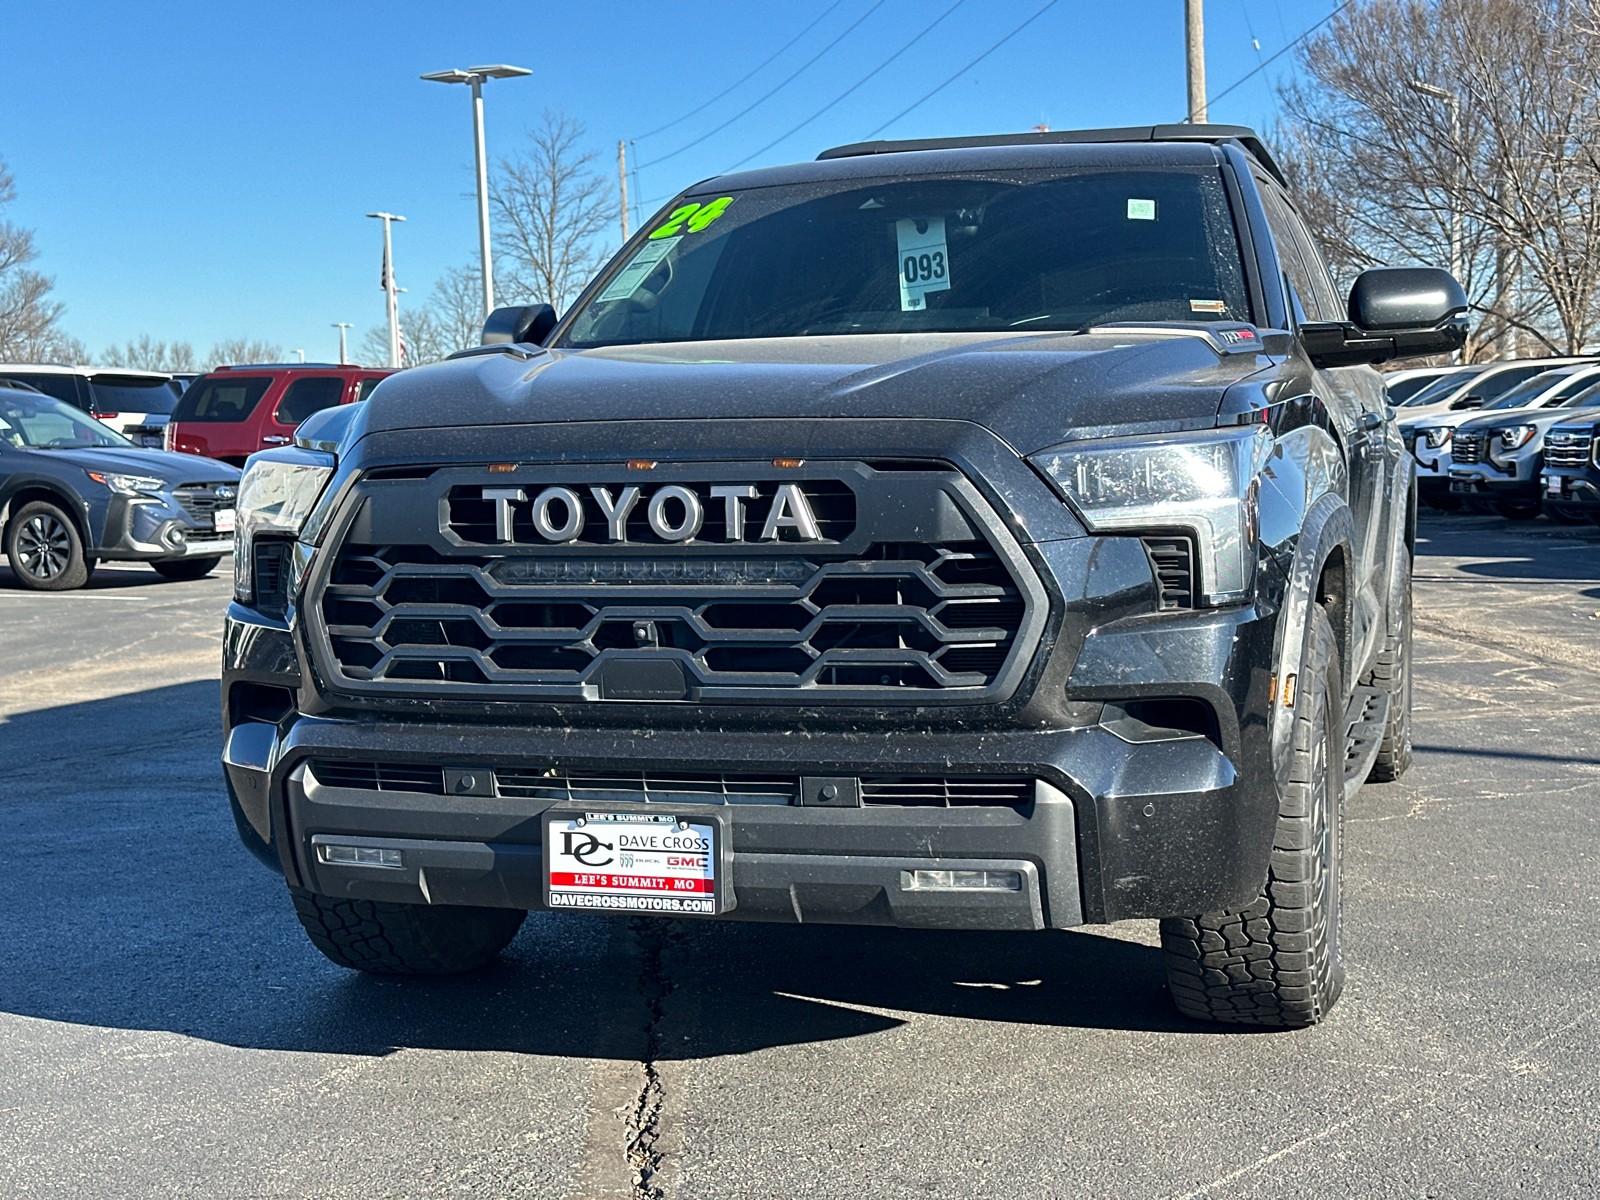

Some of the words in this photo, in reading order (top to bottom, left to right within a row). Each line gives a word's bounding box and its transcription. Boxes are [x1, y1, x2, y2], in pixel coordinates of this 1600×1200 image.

[648, 197, 734, 239] 24
[904, 251, 945, 283] 093
[481, 484, 823, 543] TOYOTA
[588, 813, 614, 821] LEE'S
[616, 814, 654, 822] SUMMIT
[619, 835, 658, 848] DAVE
[663, 836, 709, 850] CROSS
[667, 856, 708, 868] GMC
[574, 874, 607, 885] LEE'S
[612, 876, 669, 890] SUMMIT,
[674, 879, 695, 890] MO
[552, 893, 712, 912] DAVECROSSMOTORS.COM
